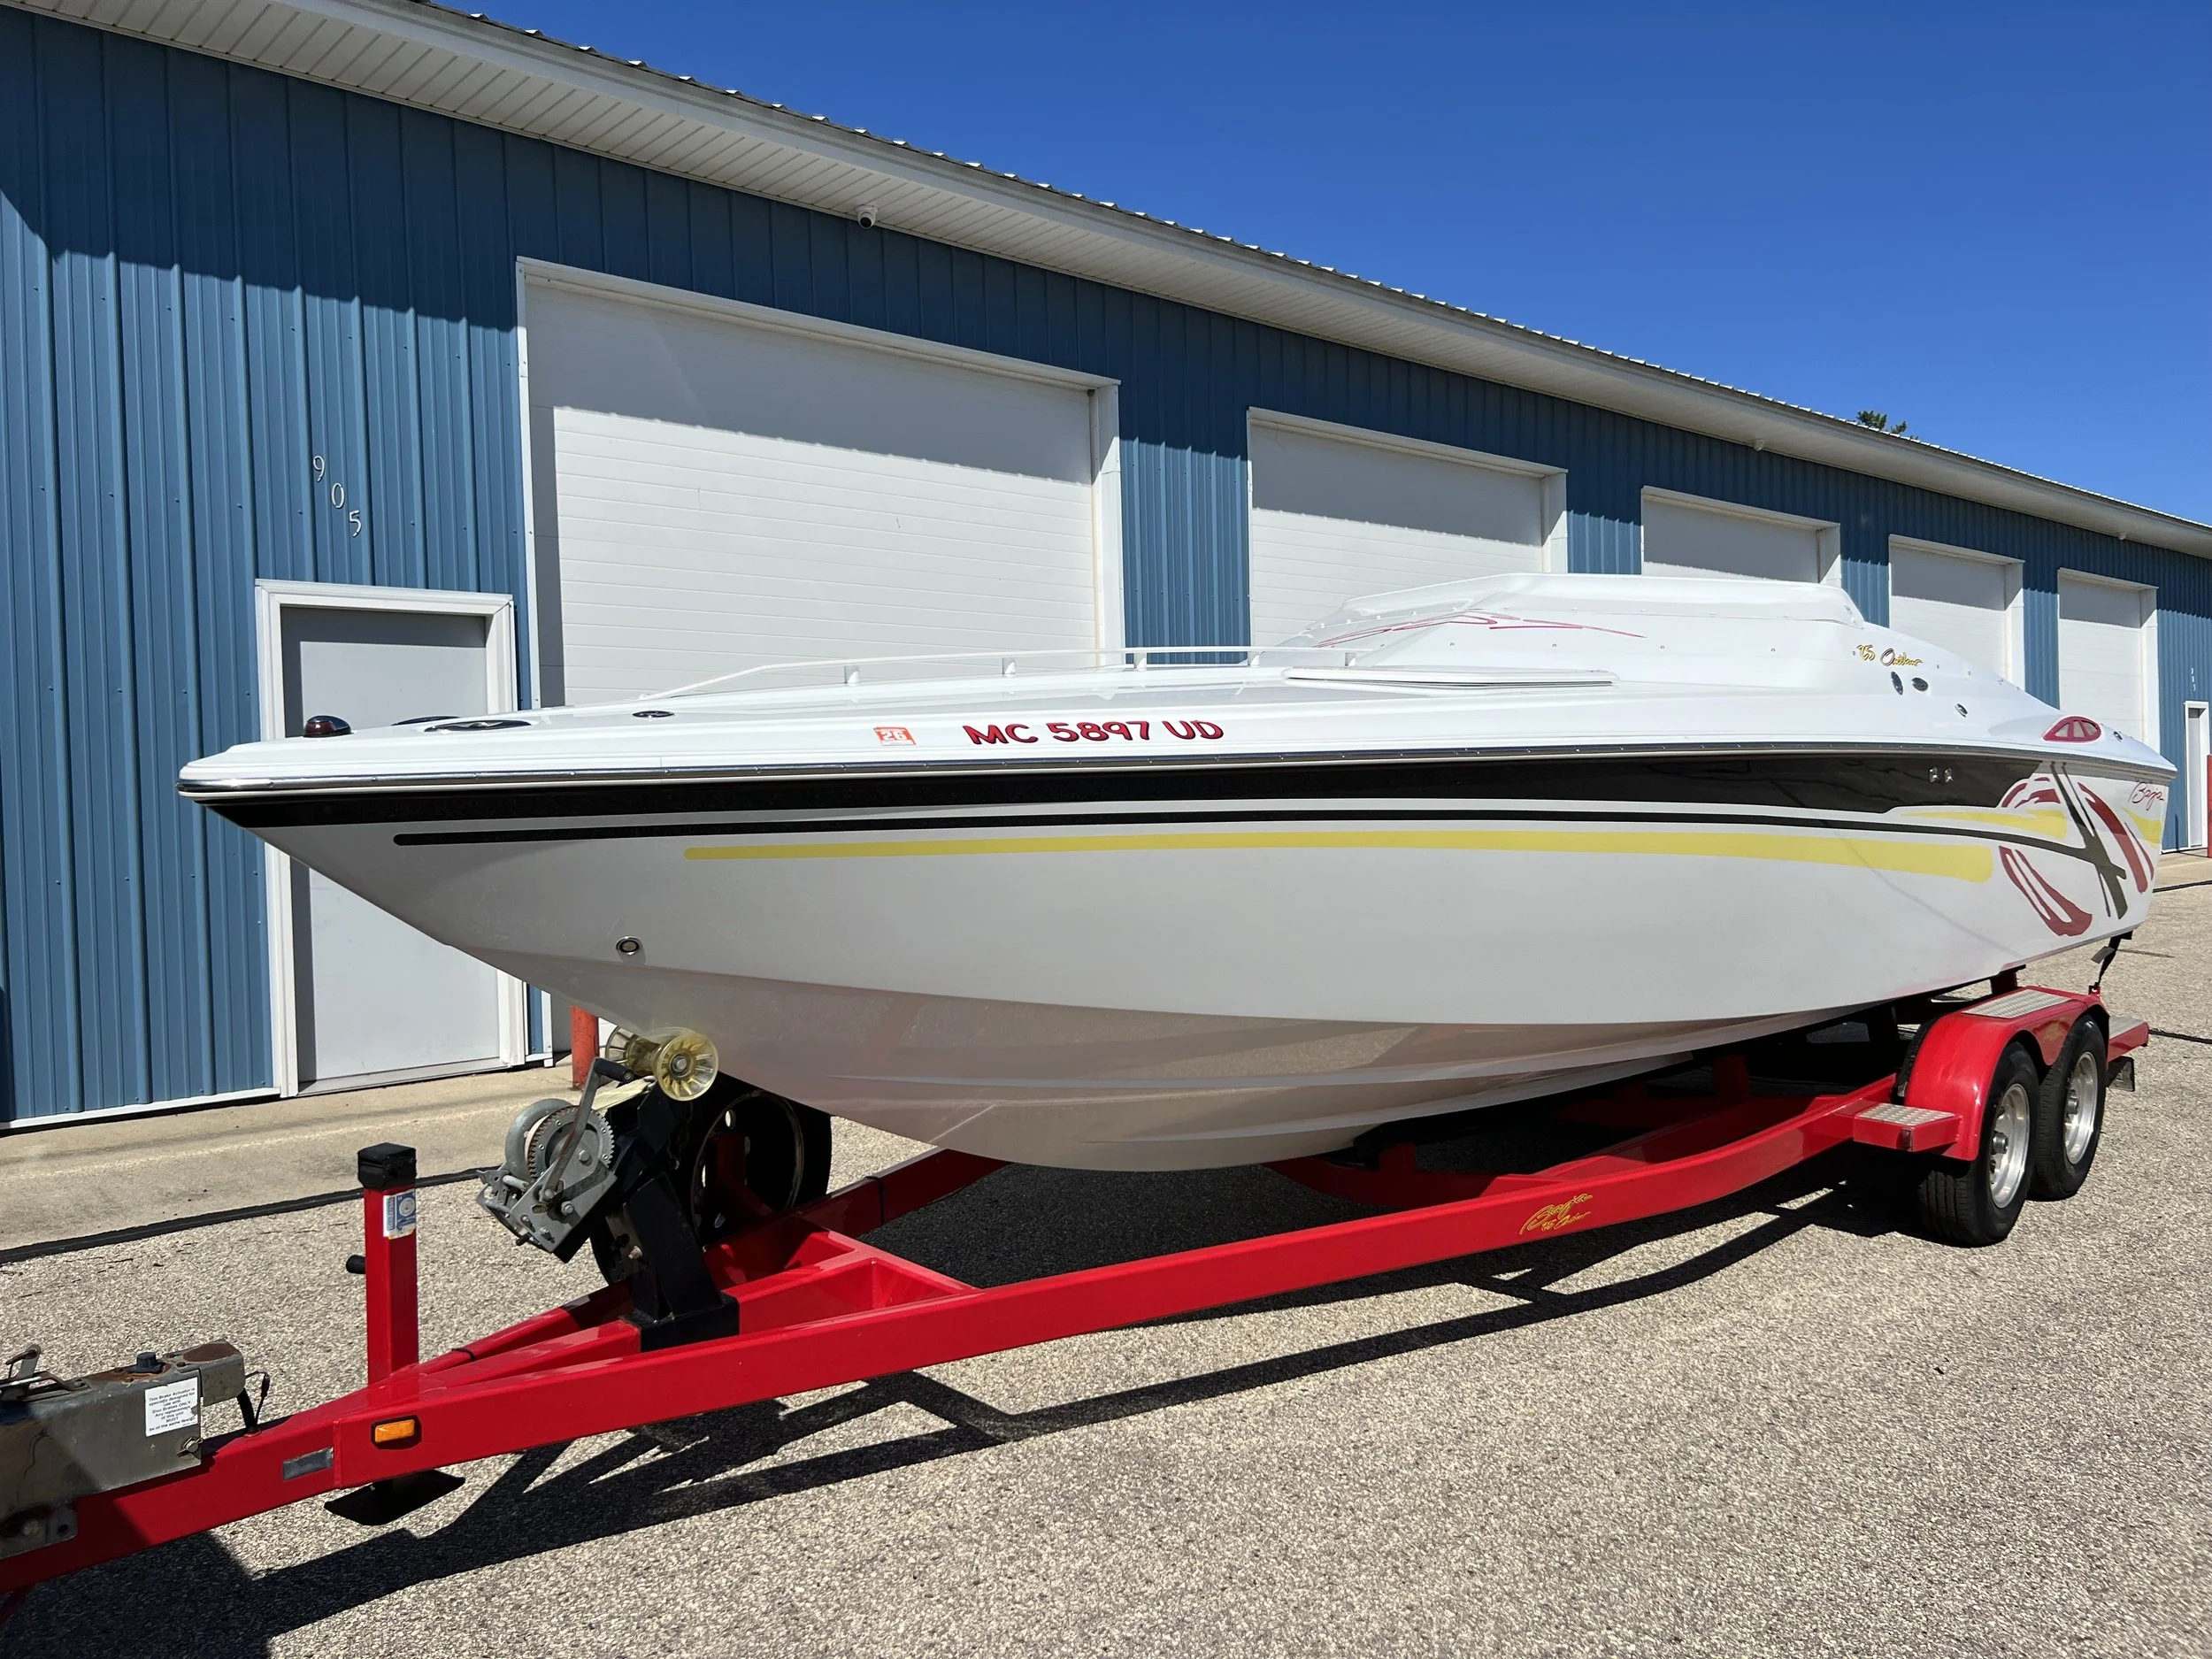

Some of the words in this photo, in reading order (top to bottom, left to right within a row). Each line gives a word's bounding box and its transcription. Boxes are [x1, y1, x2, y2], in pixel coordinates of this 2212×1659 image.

[313, 455, 362, 537] 905
[881, 730, 907, 741] 26
[963, 723, 1039, 745] MC
[1046, 721, 1149, 742] 5897
[1162, 720, 1224, 740] UD
[2128, 781, 2164, 811] Baja
